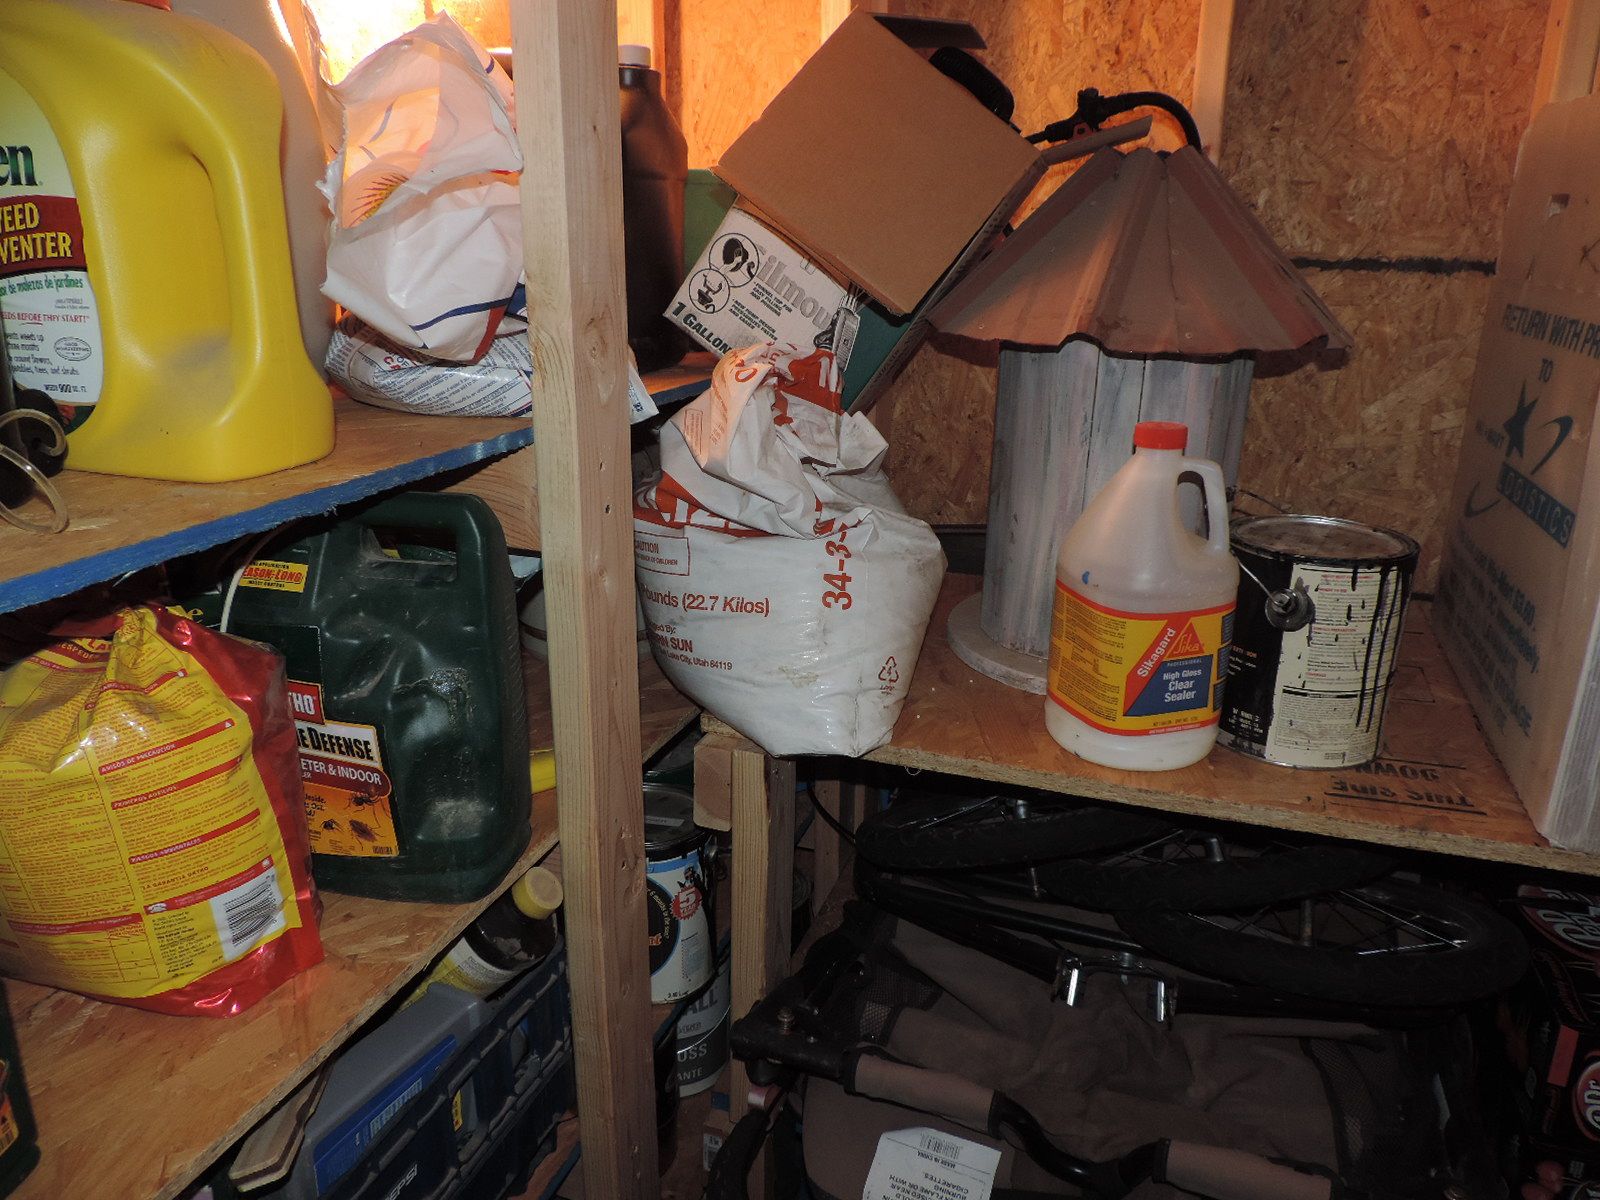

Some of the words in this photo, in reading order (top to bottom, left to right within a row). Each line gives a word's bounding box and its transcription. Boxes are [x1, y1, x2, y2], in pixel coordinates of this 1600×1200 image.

[750, 291, 760, 300] AND
[729, 308, 739, 317] AND
[782, 304, 793, 313] FOR
[671, 302, 687, 317] 1
[682, 313, 733, 355] GALLON
[1505, 303, 1549, 341] RETURN
[1548, 313, 1584, 353] WITH
[1538, 358, 1553, 383] TO
[822, 521, 855, 610] 34-3-
[682, 592, 719, 612] (22.7
[722, 596, 770, 617] Kilos)
[670, 637, 693, 653] SUN
[1173, 632, 1200, 655] Sika
[1137, 628, 1176, 677] Sikagard
[693, 657, 709, 667] Utah
[710, 660, 733, 671] 84119
[1163, 671, 1180, 681] High
[1182, 669, 1202, 677] Gloss
[1168, 680, 1195, 691] Clear
[1164, 690, 1196, 702] Sealer
[308, 727, 373, 761] DEFENSE
[328, 763, 338, 776] &
[338, 766, 382, 785] INDOOR
[679, 891, 697, 909] 5
[889, 1174, 907, 1185] WITH
[908, 1182, 918, 1190] OR
[891, 1183, 910, 1195] NEAR
